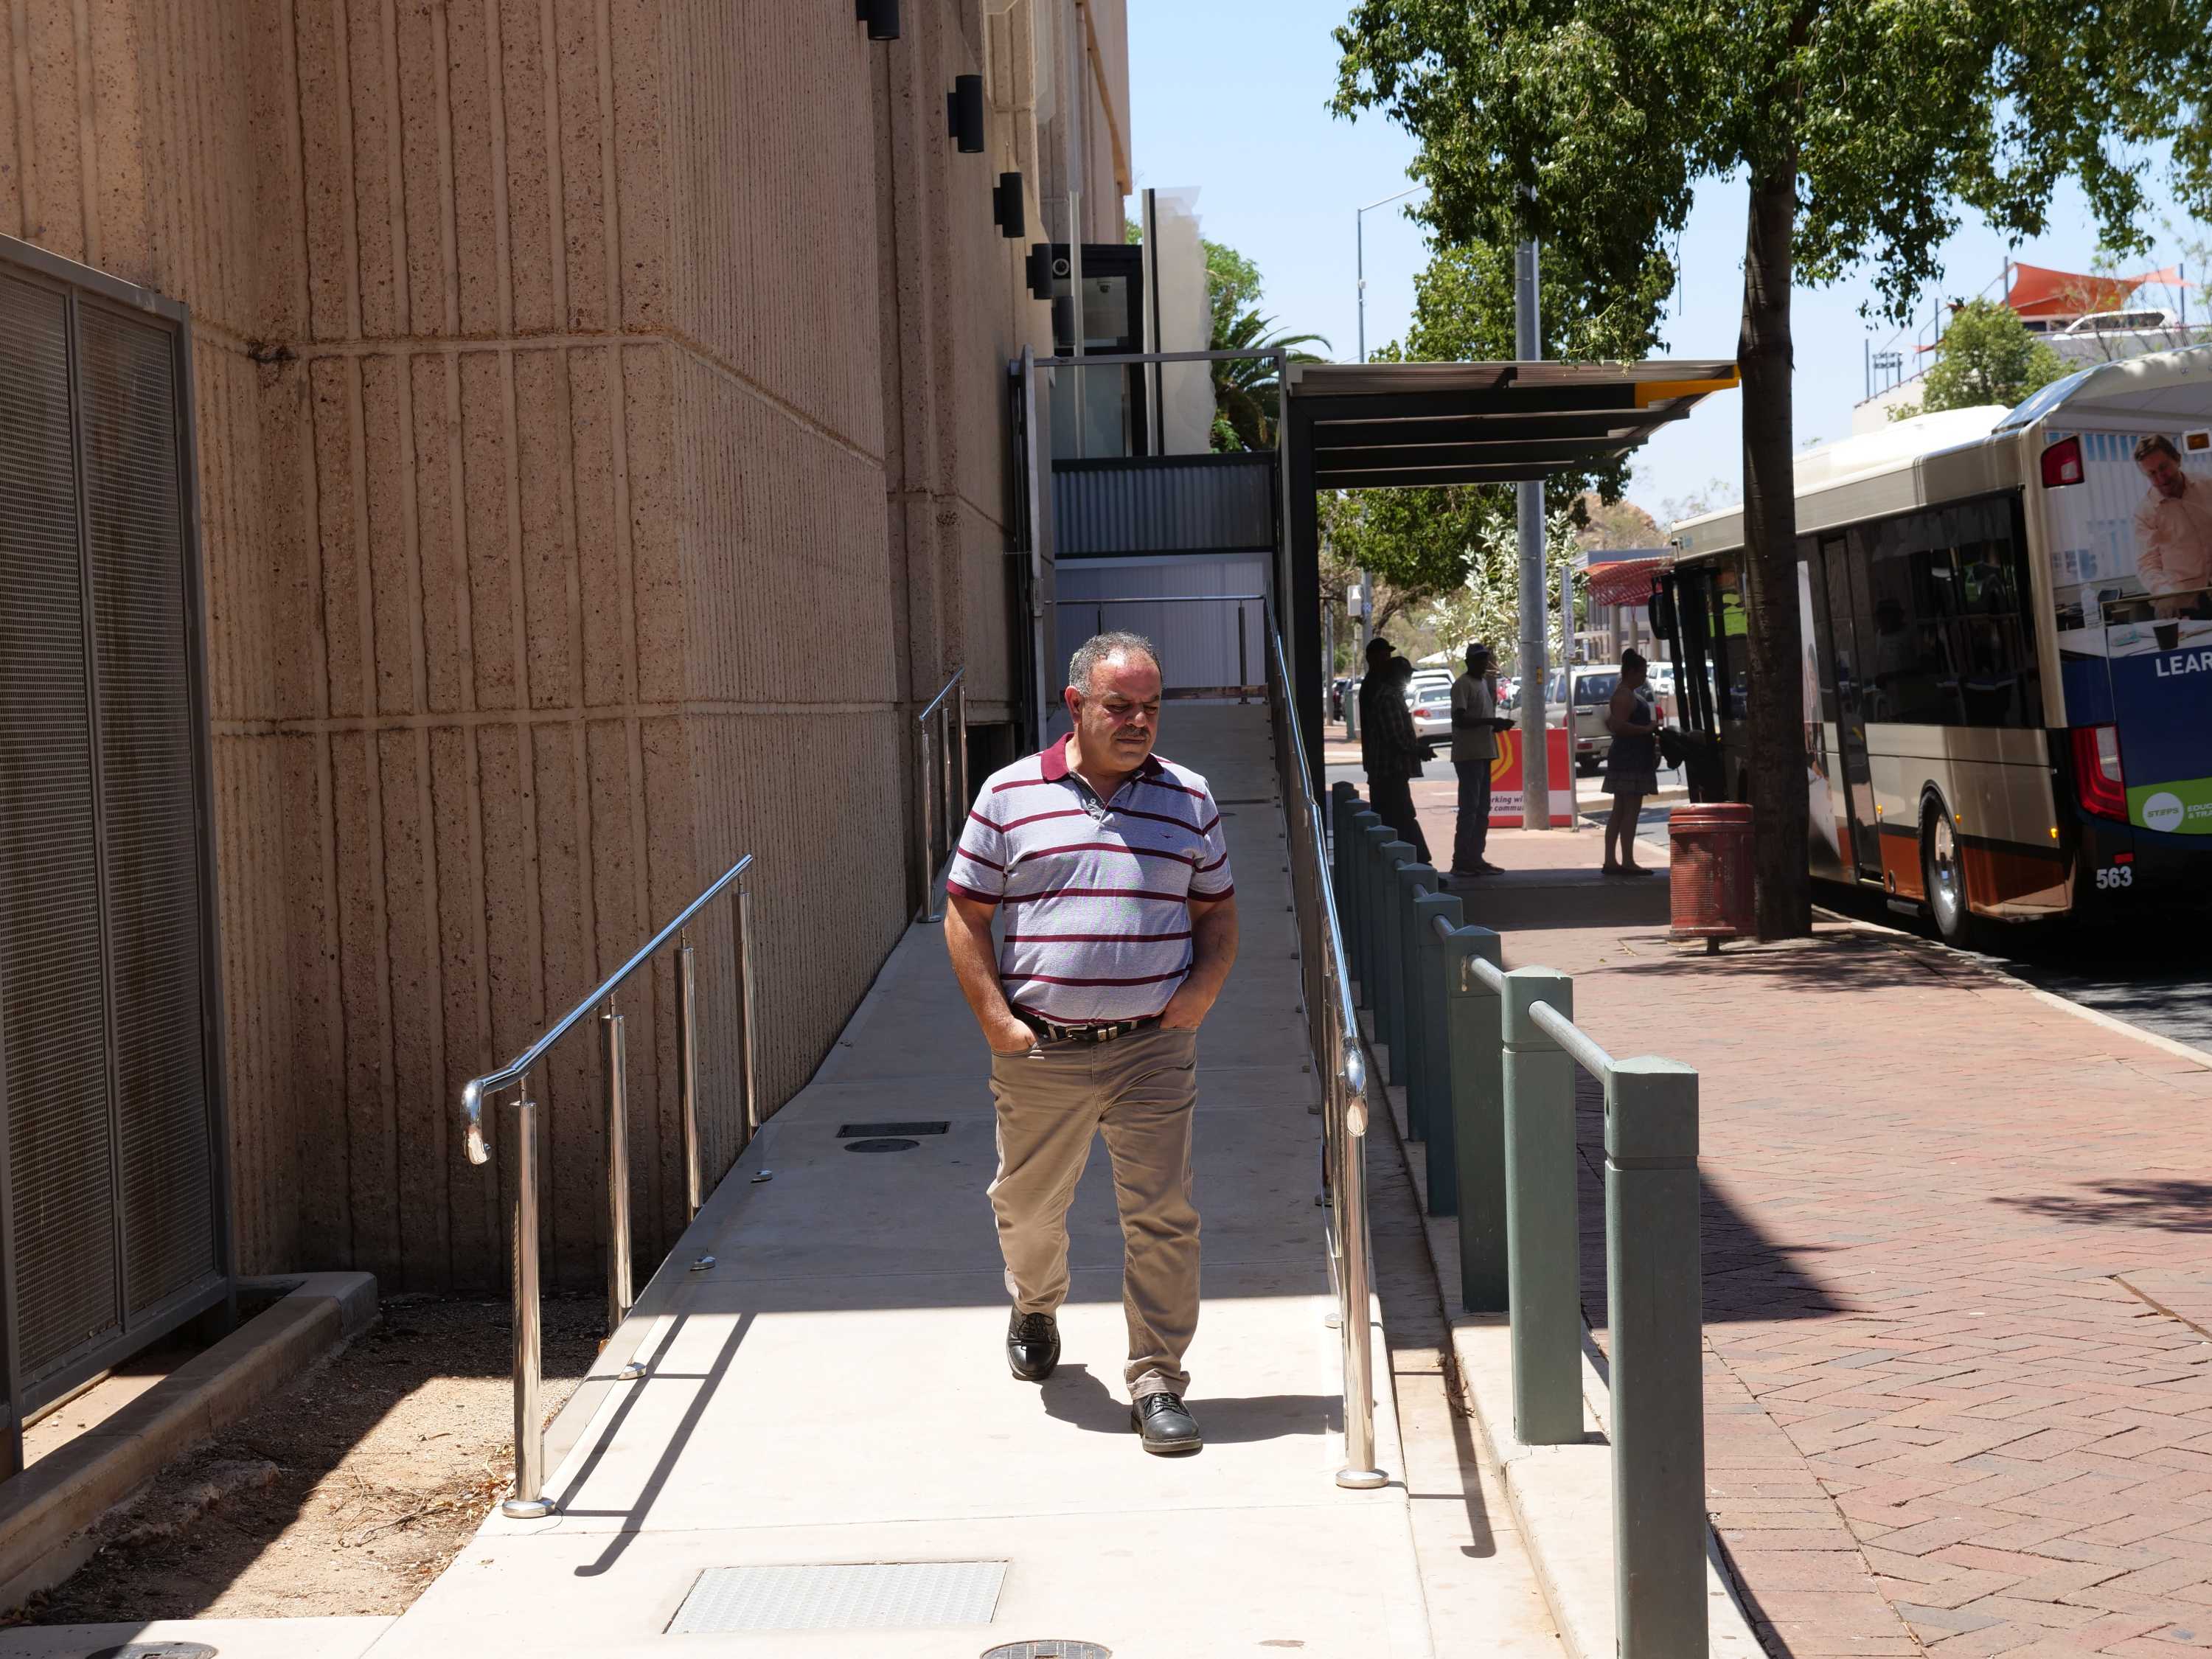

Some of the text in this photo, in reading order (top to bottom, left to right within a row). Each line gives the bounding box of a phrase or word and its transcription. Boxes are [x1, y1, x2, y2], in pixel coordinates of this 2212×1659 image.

[1490, 796, 1512, 804] rking
[2146, 807, 2180, 818] STEPS
[2096, 866, 2132, 889] 563
